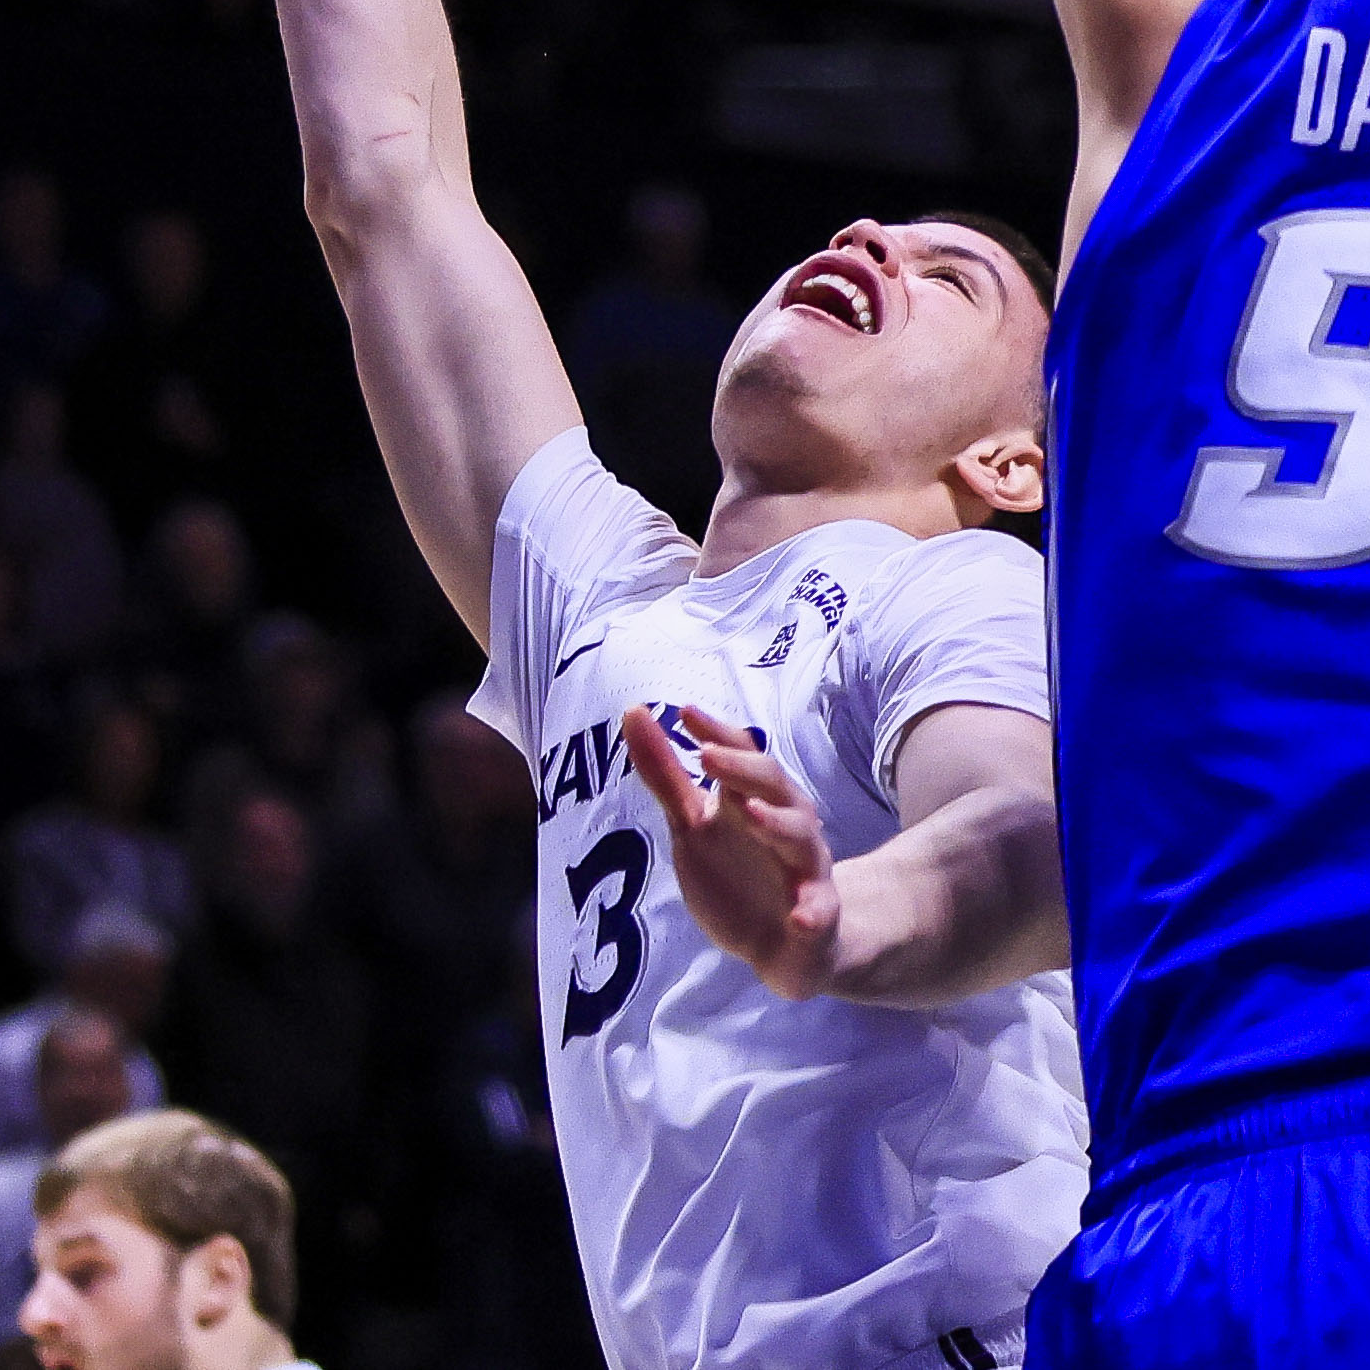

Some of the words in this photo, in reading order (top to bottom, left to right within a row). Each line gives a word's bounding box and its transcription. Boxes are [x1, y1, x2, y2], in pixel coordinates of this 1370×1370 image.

[799, 568, 830, 586] BE
[824, 582, 850, 621] TH
[757, 639, 797, 663] EAS
[538, 701, 768, 825] XAV
[561, 822, 655, 1051] 3
